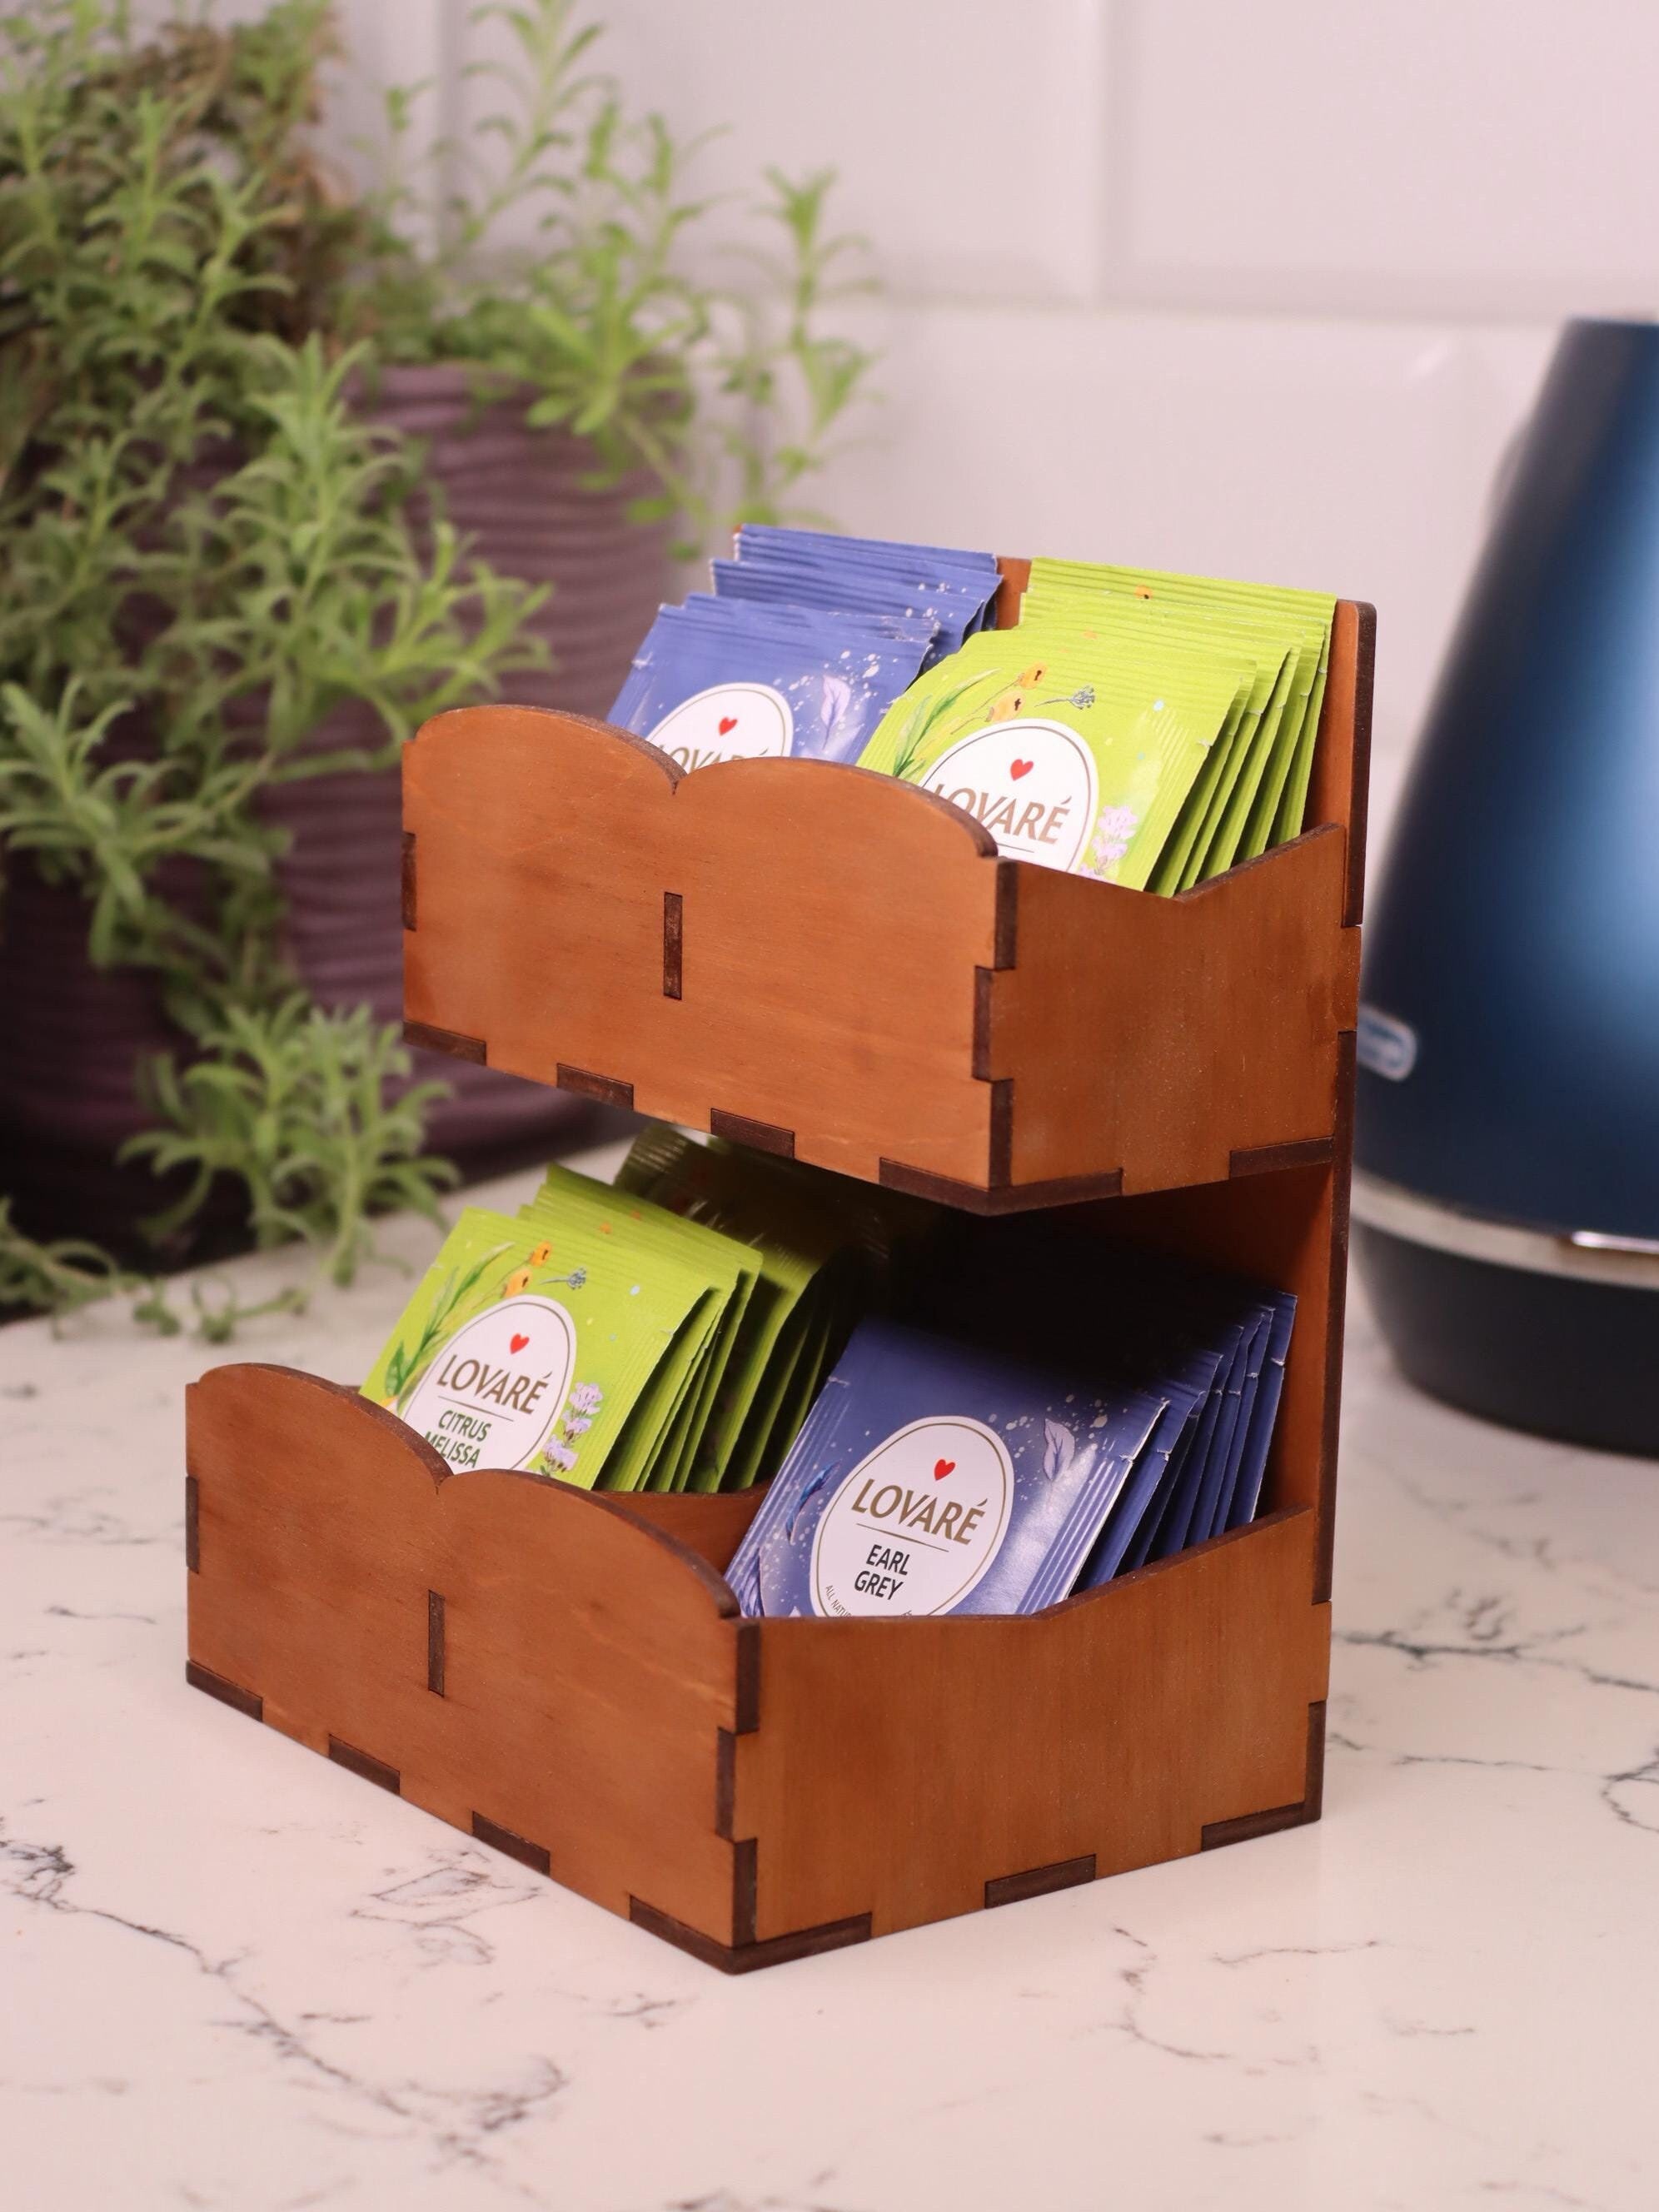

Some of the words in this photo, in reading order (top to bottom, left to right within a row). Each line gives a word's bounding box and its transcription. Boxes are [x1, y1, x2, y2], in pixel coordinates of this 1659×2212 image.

[933, 784, 1072, 844] OVARÉ
[436, 1354, 553, 1415] LOVARÉ
[438, 1410, 491, 1442] CITRUS
[851, 1478, 989, 1546] LOVARÉ
[866, 1544, 910, 1576] EARL
[854, 1570, 904, 1601] GREY
[830, 1599, 852, 1617] NATU
